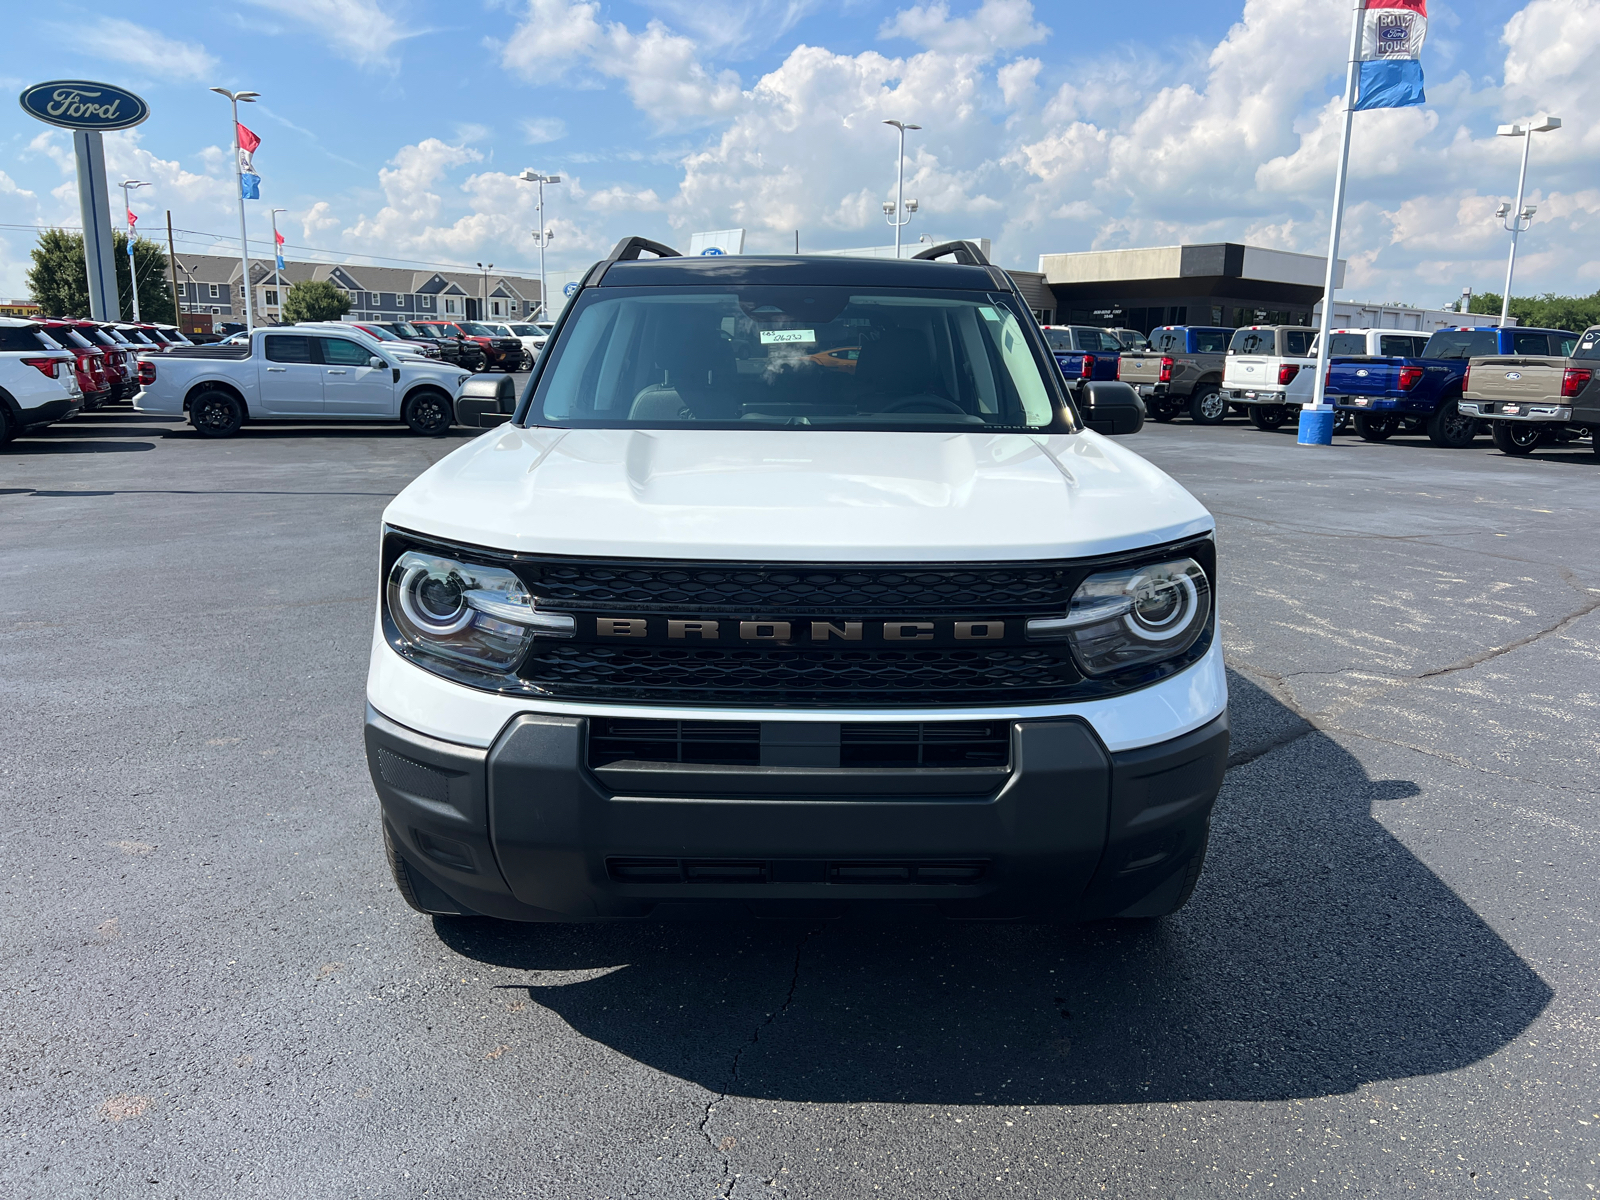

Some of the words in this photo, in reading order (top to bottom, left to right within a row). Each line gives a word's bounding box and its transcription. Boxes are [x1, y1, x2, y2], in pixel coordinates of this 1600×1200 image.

[1380, 41, 1409, 51] TOUG
[47, 88, 121, 119] Ford
[596, 616, 1005, 641] BRONCO
